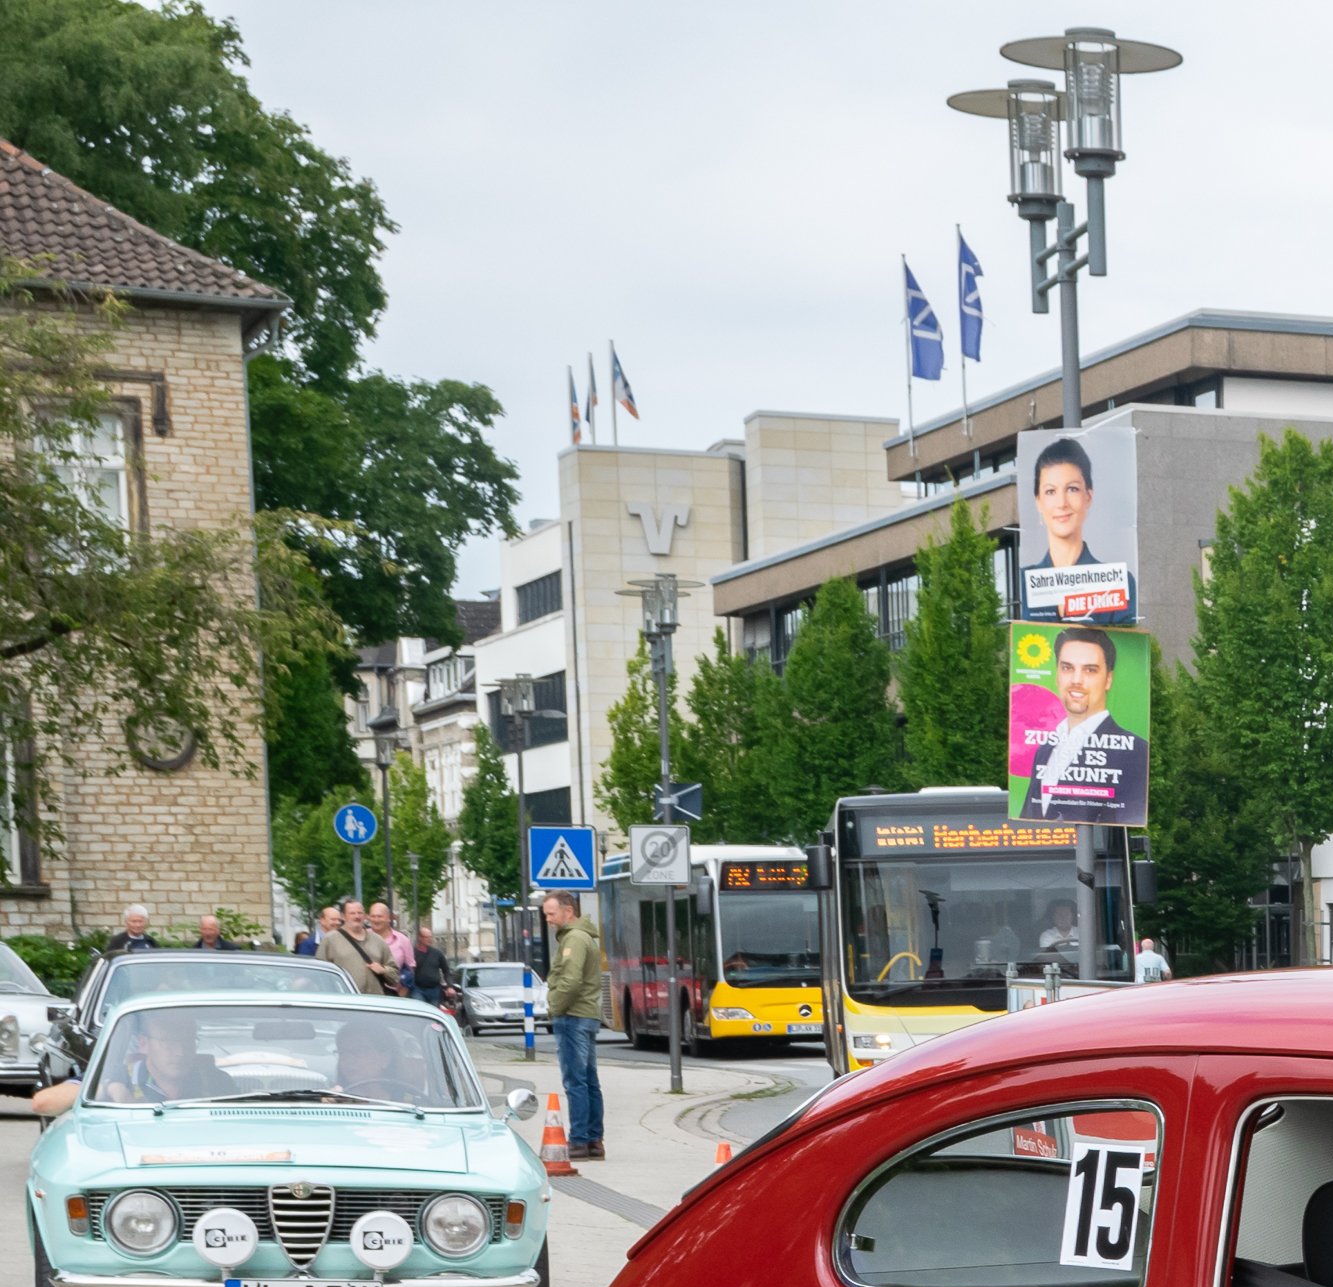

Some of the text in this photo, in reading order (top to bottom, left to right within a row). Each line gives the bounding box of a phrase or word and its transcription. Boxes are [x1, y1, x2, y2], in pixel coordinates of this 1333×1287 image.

[1030, 568, 1123, 589] Sahra Wagenknecht
[1068, 596, 1087, 612] DIE
[1024, 729, 1135, 751] ZUSAMMEN
[1053, 749, 1107, 766] IST ES
[1035, 764, 1122, 785] ZUKUNFT
[1048, 786, 1109, 798] ROBIN WAGENER
[649, 840, 671, 859] 20
[645, 869, 675, 880] ZONE
[1016, 1135, 1058, 1158] Martin Schulz
[1073, 1149, 1141, 1260] 15
